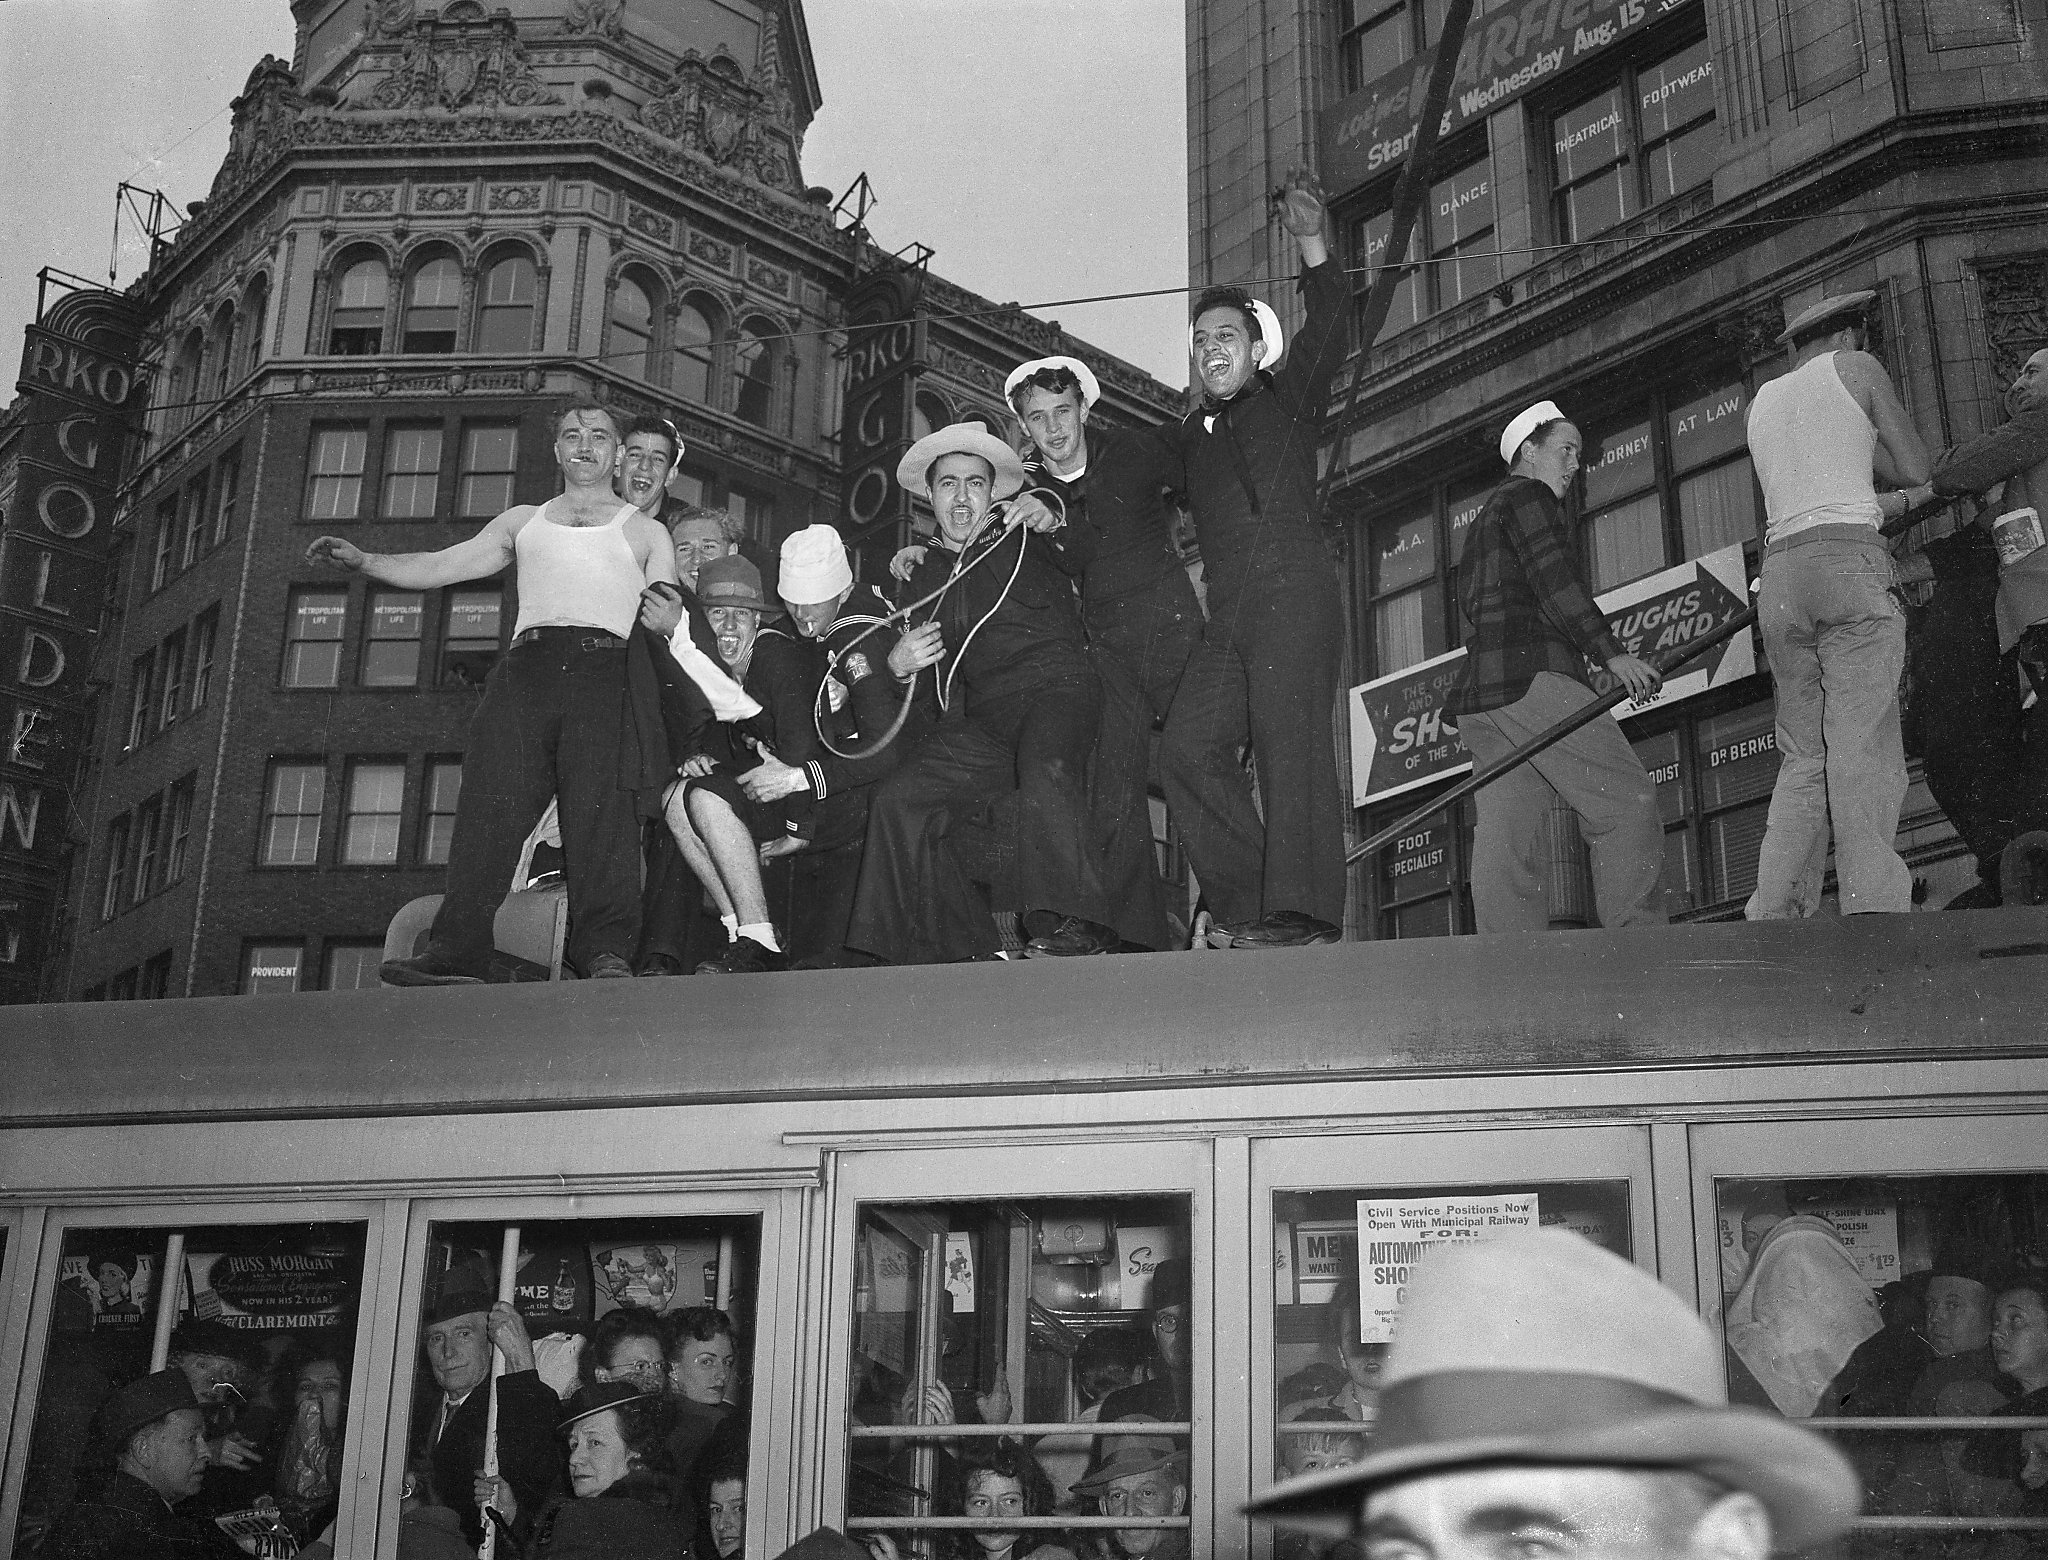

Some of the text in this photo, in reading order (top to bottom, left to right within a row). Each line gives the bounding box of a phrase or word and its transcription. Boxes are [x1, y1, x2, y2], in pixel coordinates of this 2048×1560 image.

[1459, 46, 1565, 118] Wednesday
[1572, 19, 1618, 56] Aug.
[1554, 111, 1623, 155] THEATRICAL
[1439, 181, 1490, 217] DANCE
[848, 321, 911, 392] RKO
[31, 336, 130, 404] RKO
[1677, 396, 1740, 437] AT LAW
[298, 606, 346, 615] METROPOLITAN
[375, 606, 423, 615] METROPOLITAN
[452, 604, 500, 613] METROPOLITAN
[312, 616, 328, 625] LIFE
[389, 615, 405, 624] LIFE
[467, 614, 482, 623] LIFE
[1655, 612, 1714, 651] AND
[1402, 682, 1426, 701] THE
[1407, 695, 1434, 714] AND
[1405, 755, 1422, 770] OF
[1428, 745, 1448, 762] THE
[1397, 830, 1432, 854] FOOT
[1388, 849, 1444, 878] SPECIALIST
[251, 966, 298, 978] PROVIDENT
[1368, 1203, 1529, 1218] Civil Service Positions Now
[1865, 1207, 1887, 1216] WAX
[1368, 1219, 1396, 1230] Open
[1401, 1218, 1427, 1228] With
[1431, 1216, 1484, 1228] Municipal
[1488, 1215, 1530, 1226] Railway
[1836, 1222, 1868, 1231] POLISH
[1420, 1229, 1479, 1239] FOR:
[228, 1254, 335, 1273] RUSS MORGAN
[241, 1297, 264, 1305] NOW
[266, 1297, 276, 1305] IN
[278, 1297, 293, 1305] HIS
[238, 1314, 328, 1330] CLAREMONT
